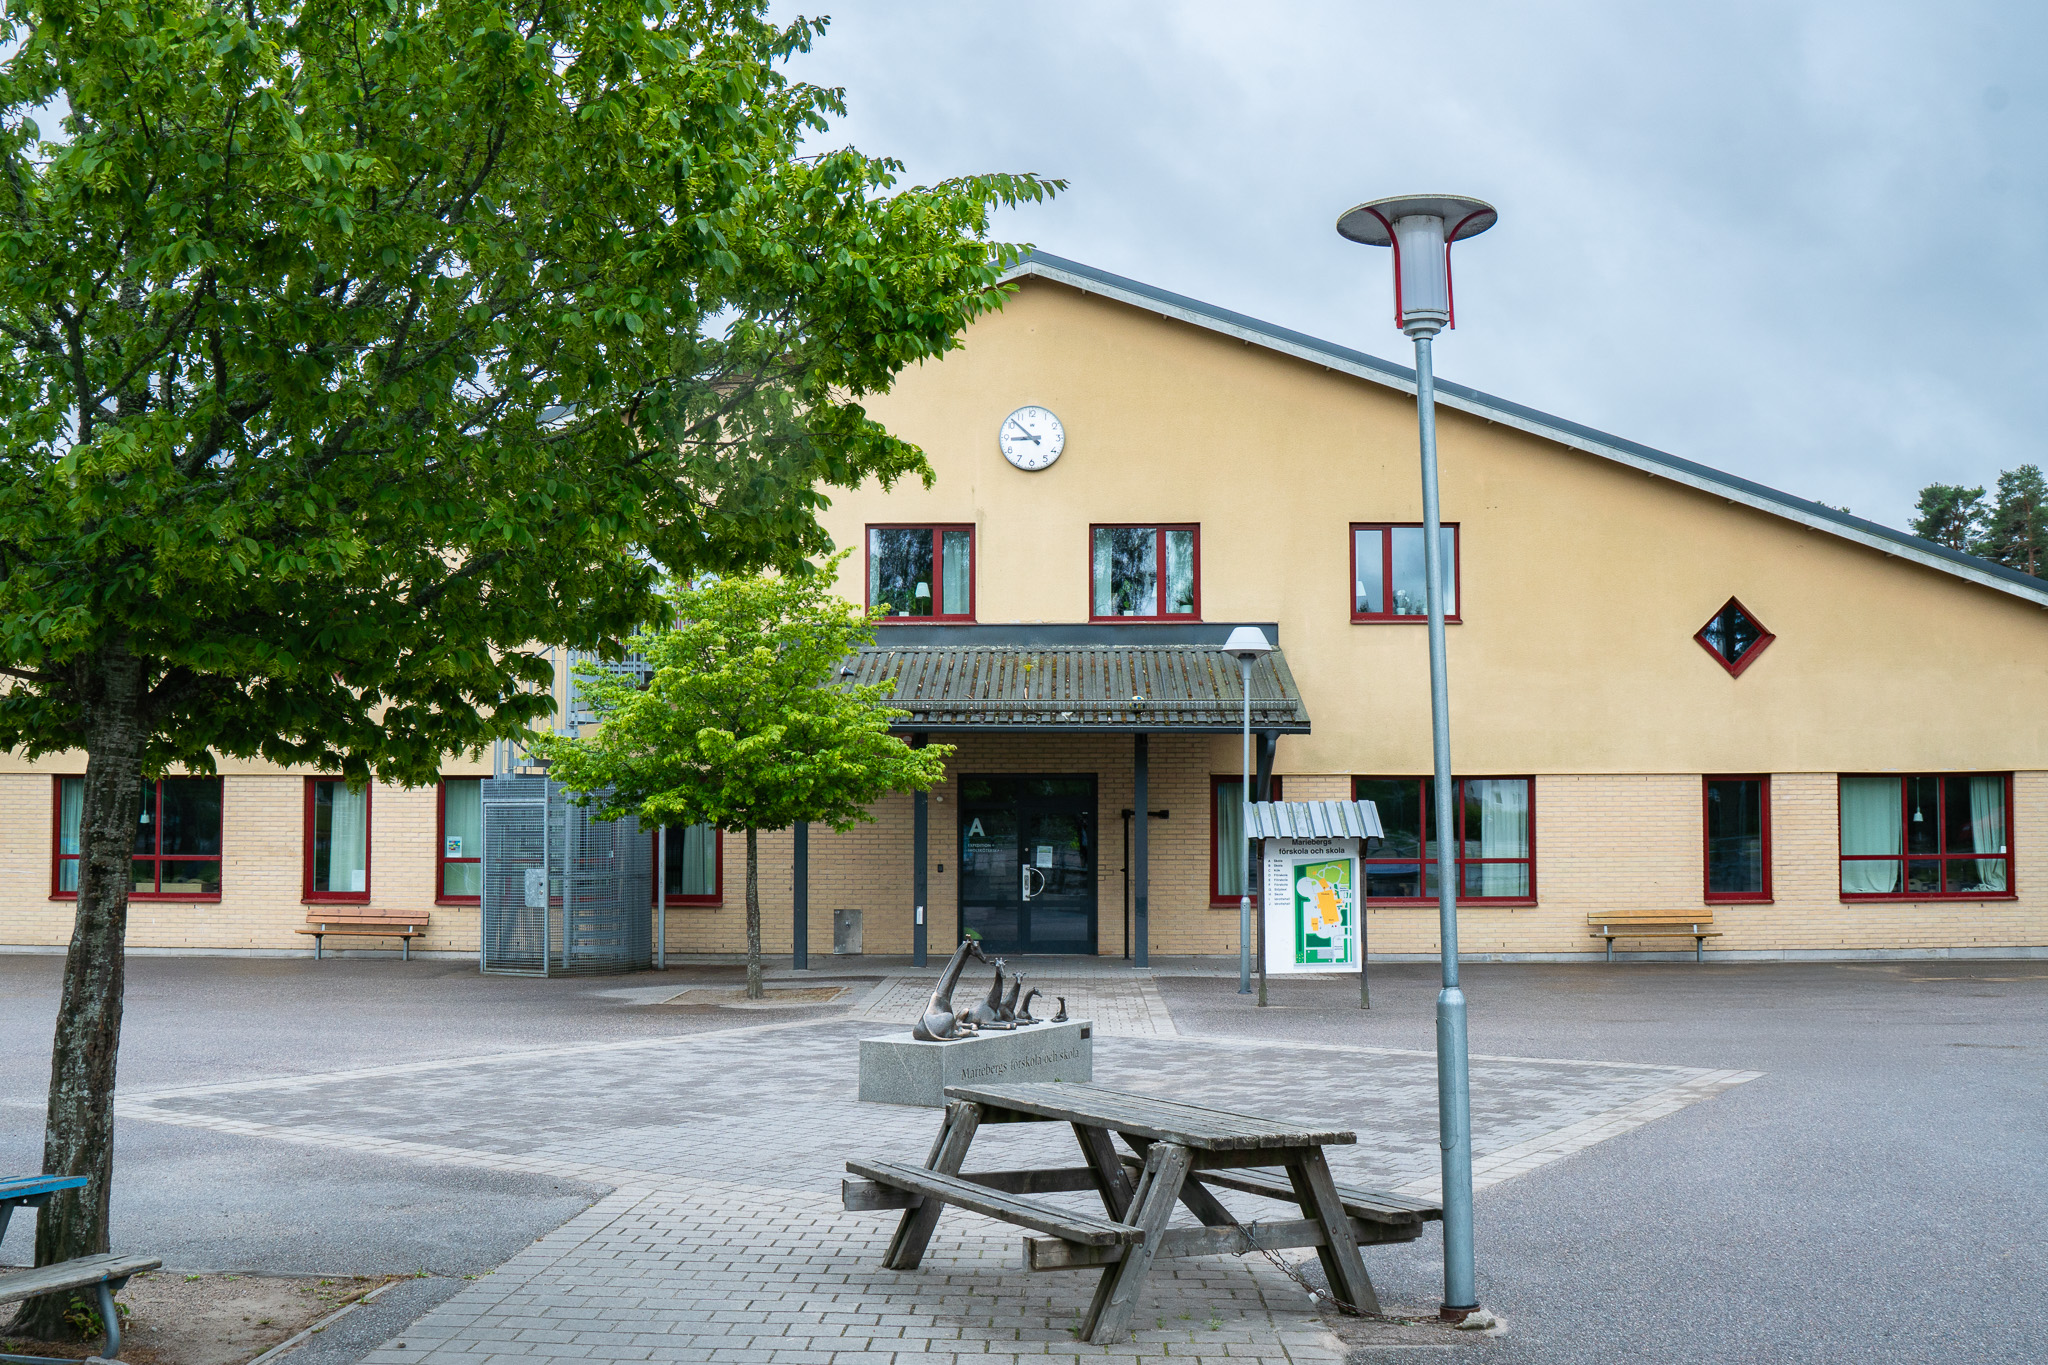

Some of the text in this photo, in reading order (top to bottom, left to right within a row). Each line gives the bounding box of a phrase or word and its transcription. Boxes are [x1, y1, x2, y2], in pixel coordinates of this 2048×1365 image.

[968, 818, 985, 836] A
[1292, 839, 1332, 847] Mariebergs
[962, 1062, 1008, 1080] Mariebergs
[1044, 1050, 1058, 1063] och
[1060, 1047, 1079, 1060] skola
